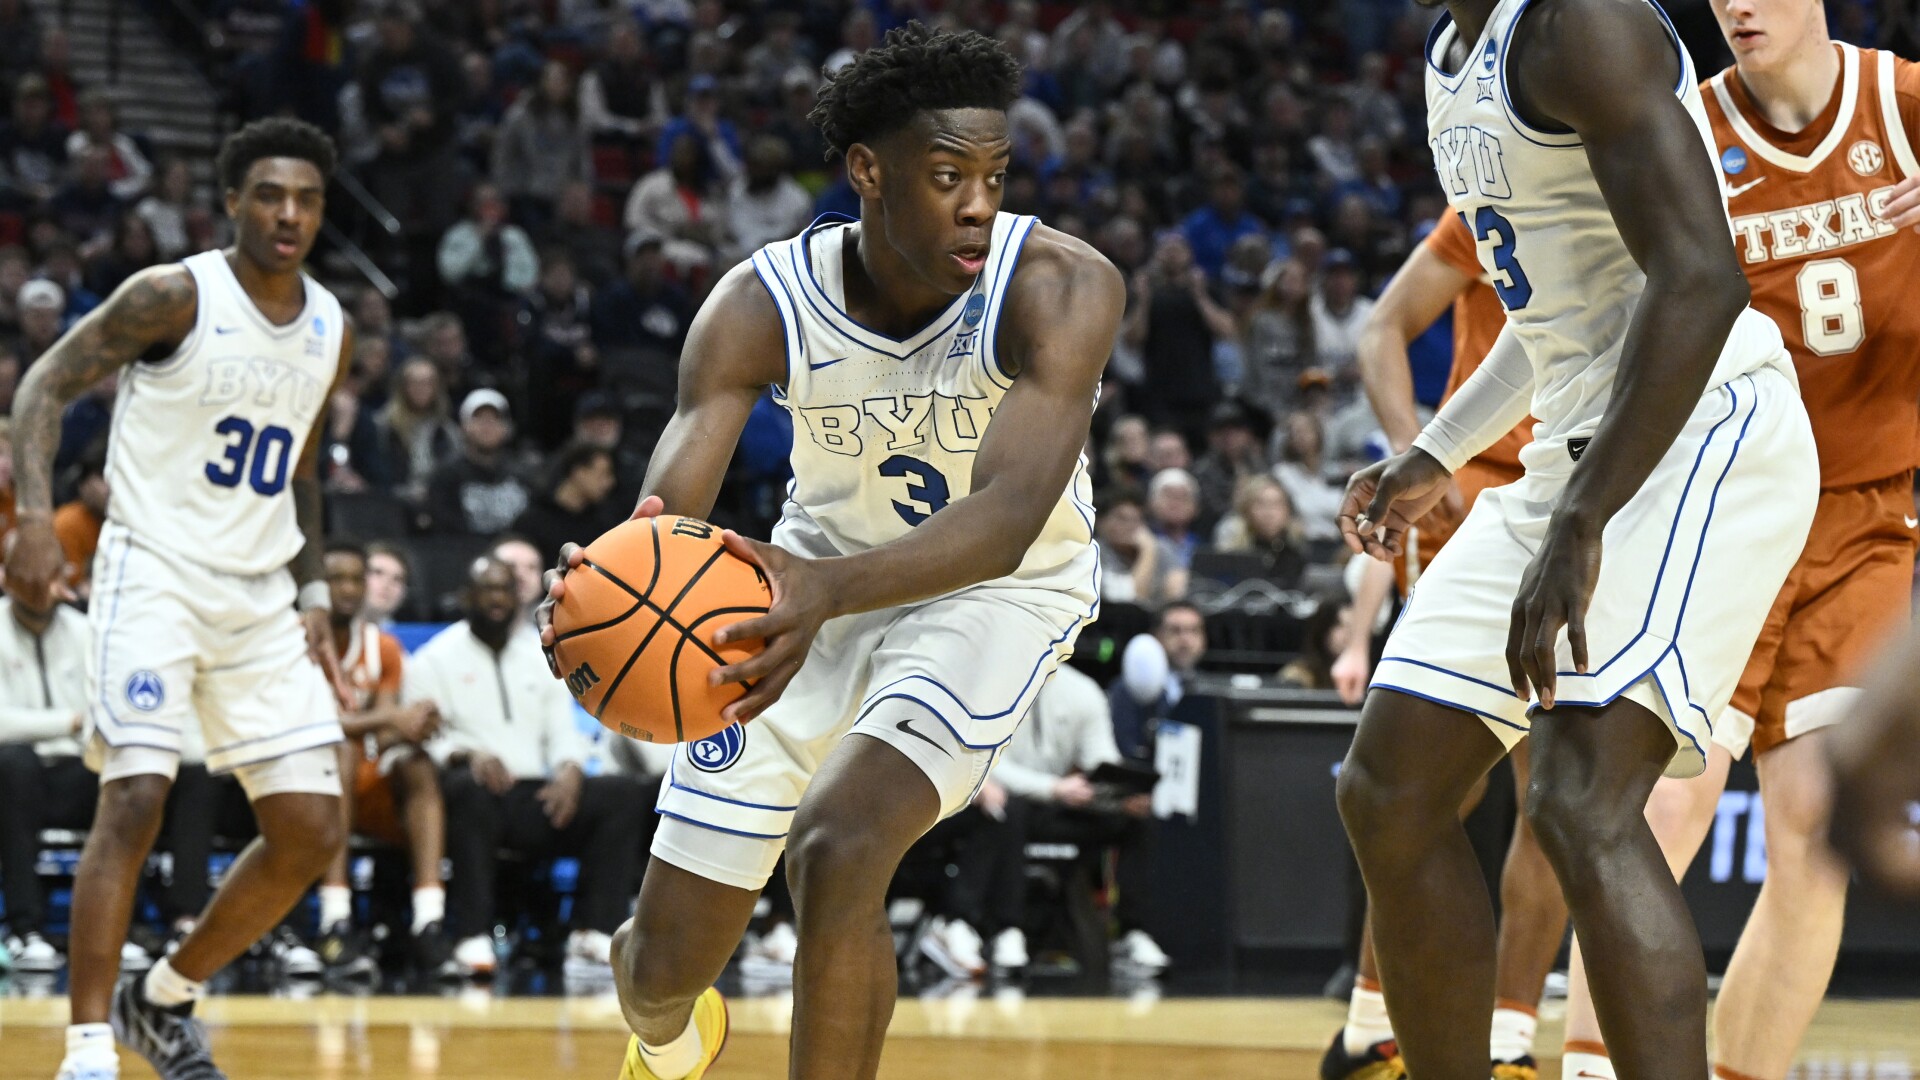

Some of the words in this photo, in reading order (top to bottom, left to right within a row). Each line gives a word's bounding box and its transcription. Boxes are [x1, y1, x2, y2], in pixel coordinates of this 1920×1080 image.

[1431, 126, 1512, 199] YU
[1850, 143, 1882, 174] SEC
[1457, 205, 1533, 311] 3
[1731, 184, 1899, 264] TEXAS
[1796, 257, 1866, 357] 8
[204, 415, 294, 497] 30
[797, 389, 995, 458] BYU
[877, 454, 951, 527] 3
